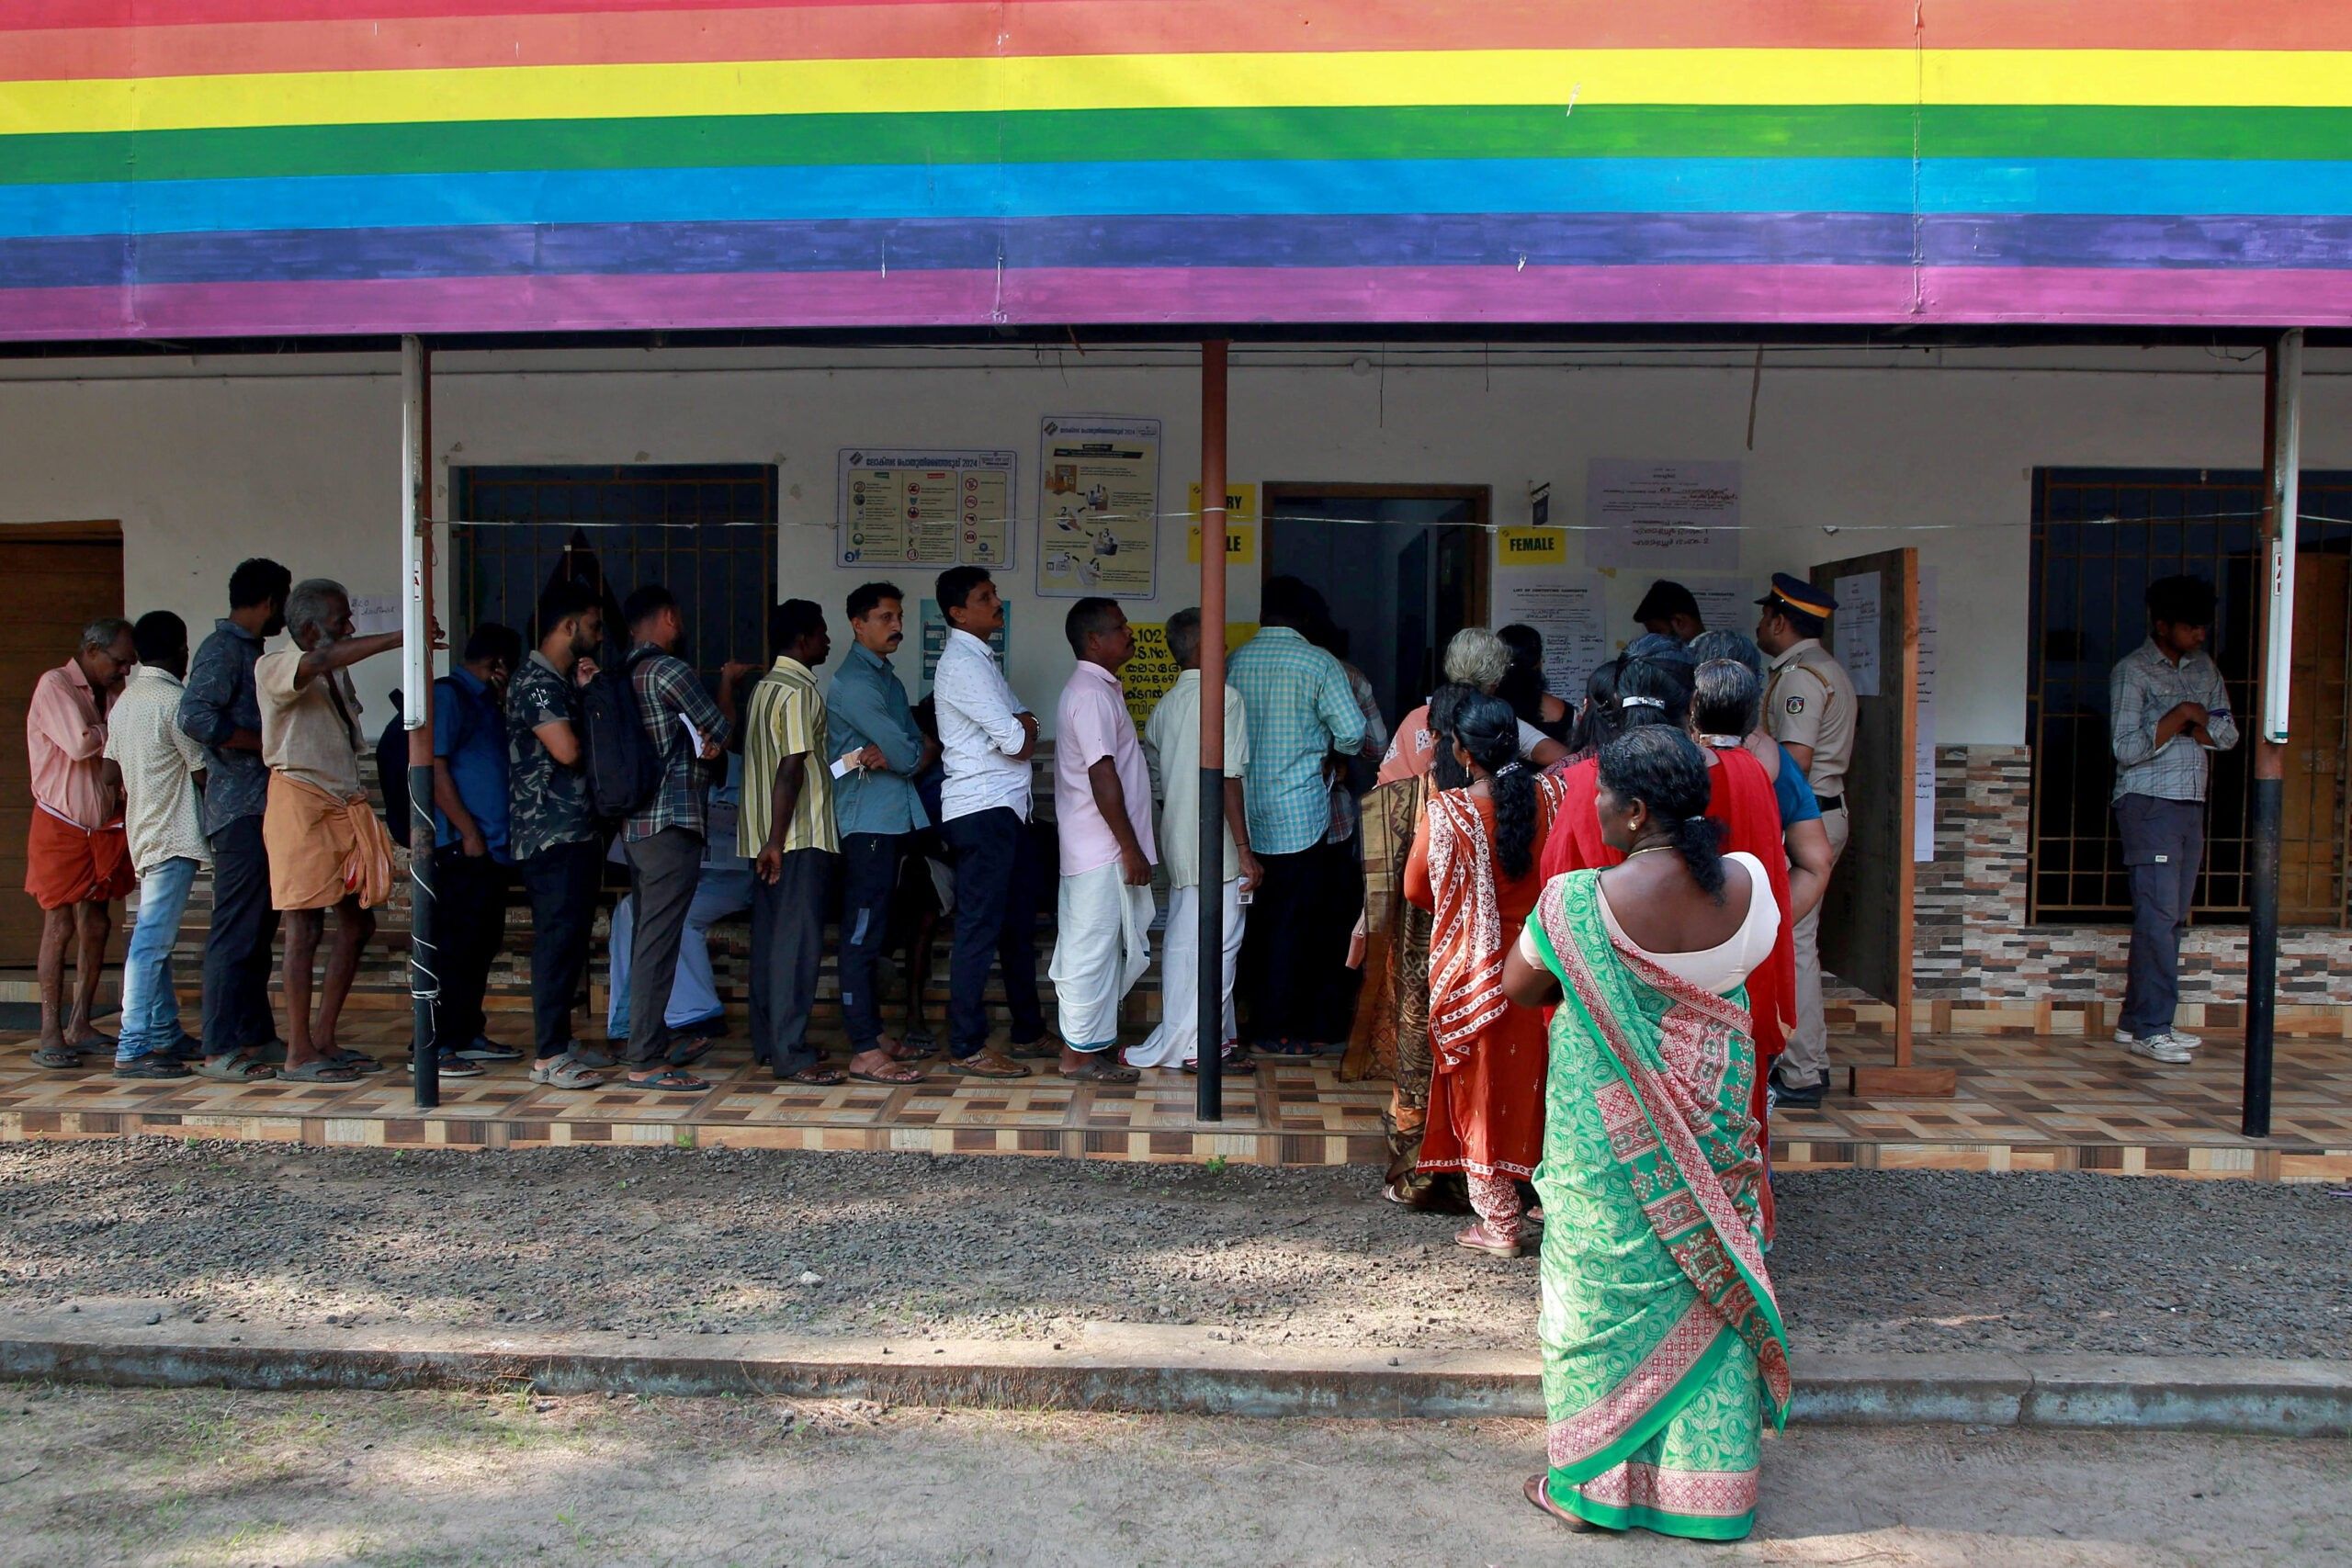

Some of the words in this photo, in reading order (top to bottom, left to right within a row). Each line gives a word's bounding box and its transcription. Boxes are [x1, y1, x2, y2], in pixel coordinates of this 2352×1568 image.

[962, 458, 978, 468] 2024
[1061, 506, 1068, 516] 2
[1226, 536, 1241, 551] LE
[1510, 537, 1555, 551] FEMALE
[1129, 674, 1181, 683] 904869
